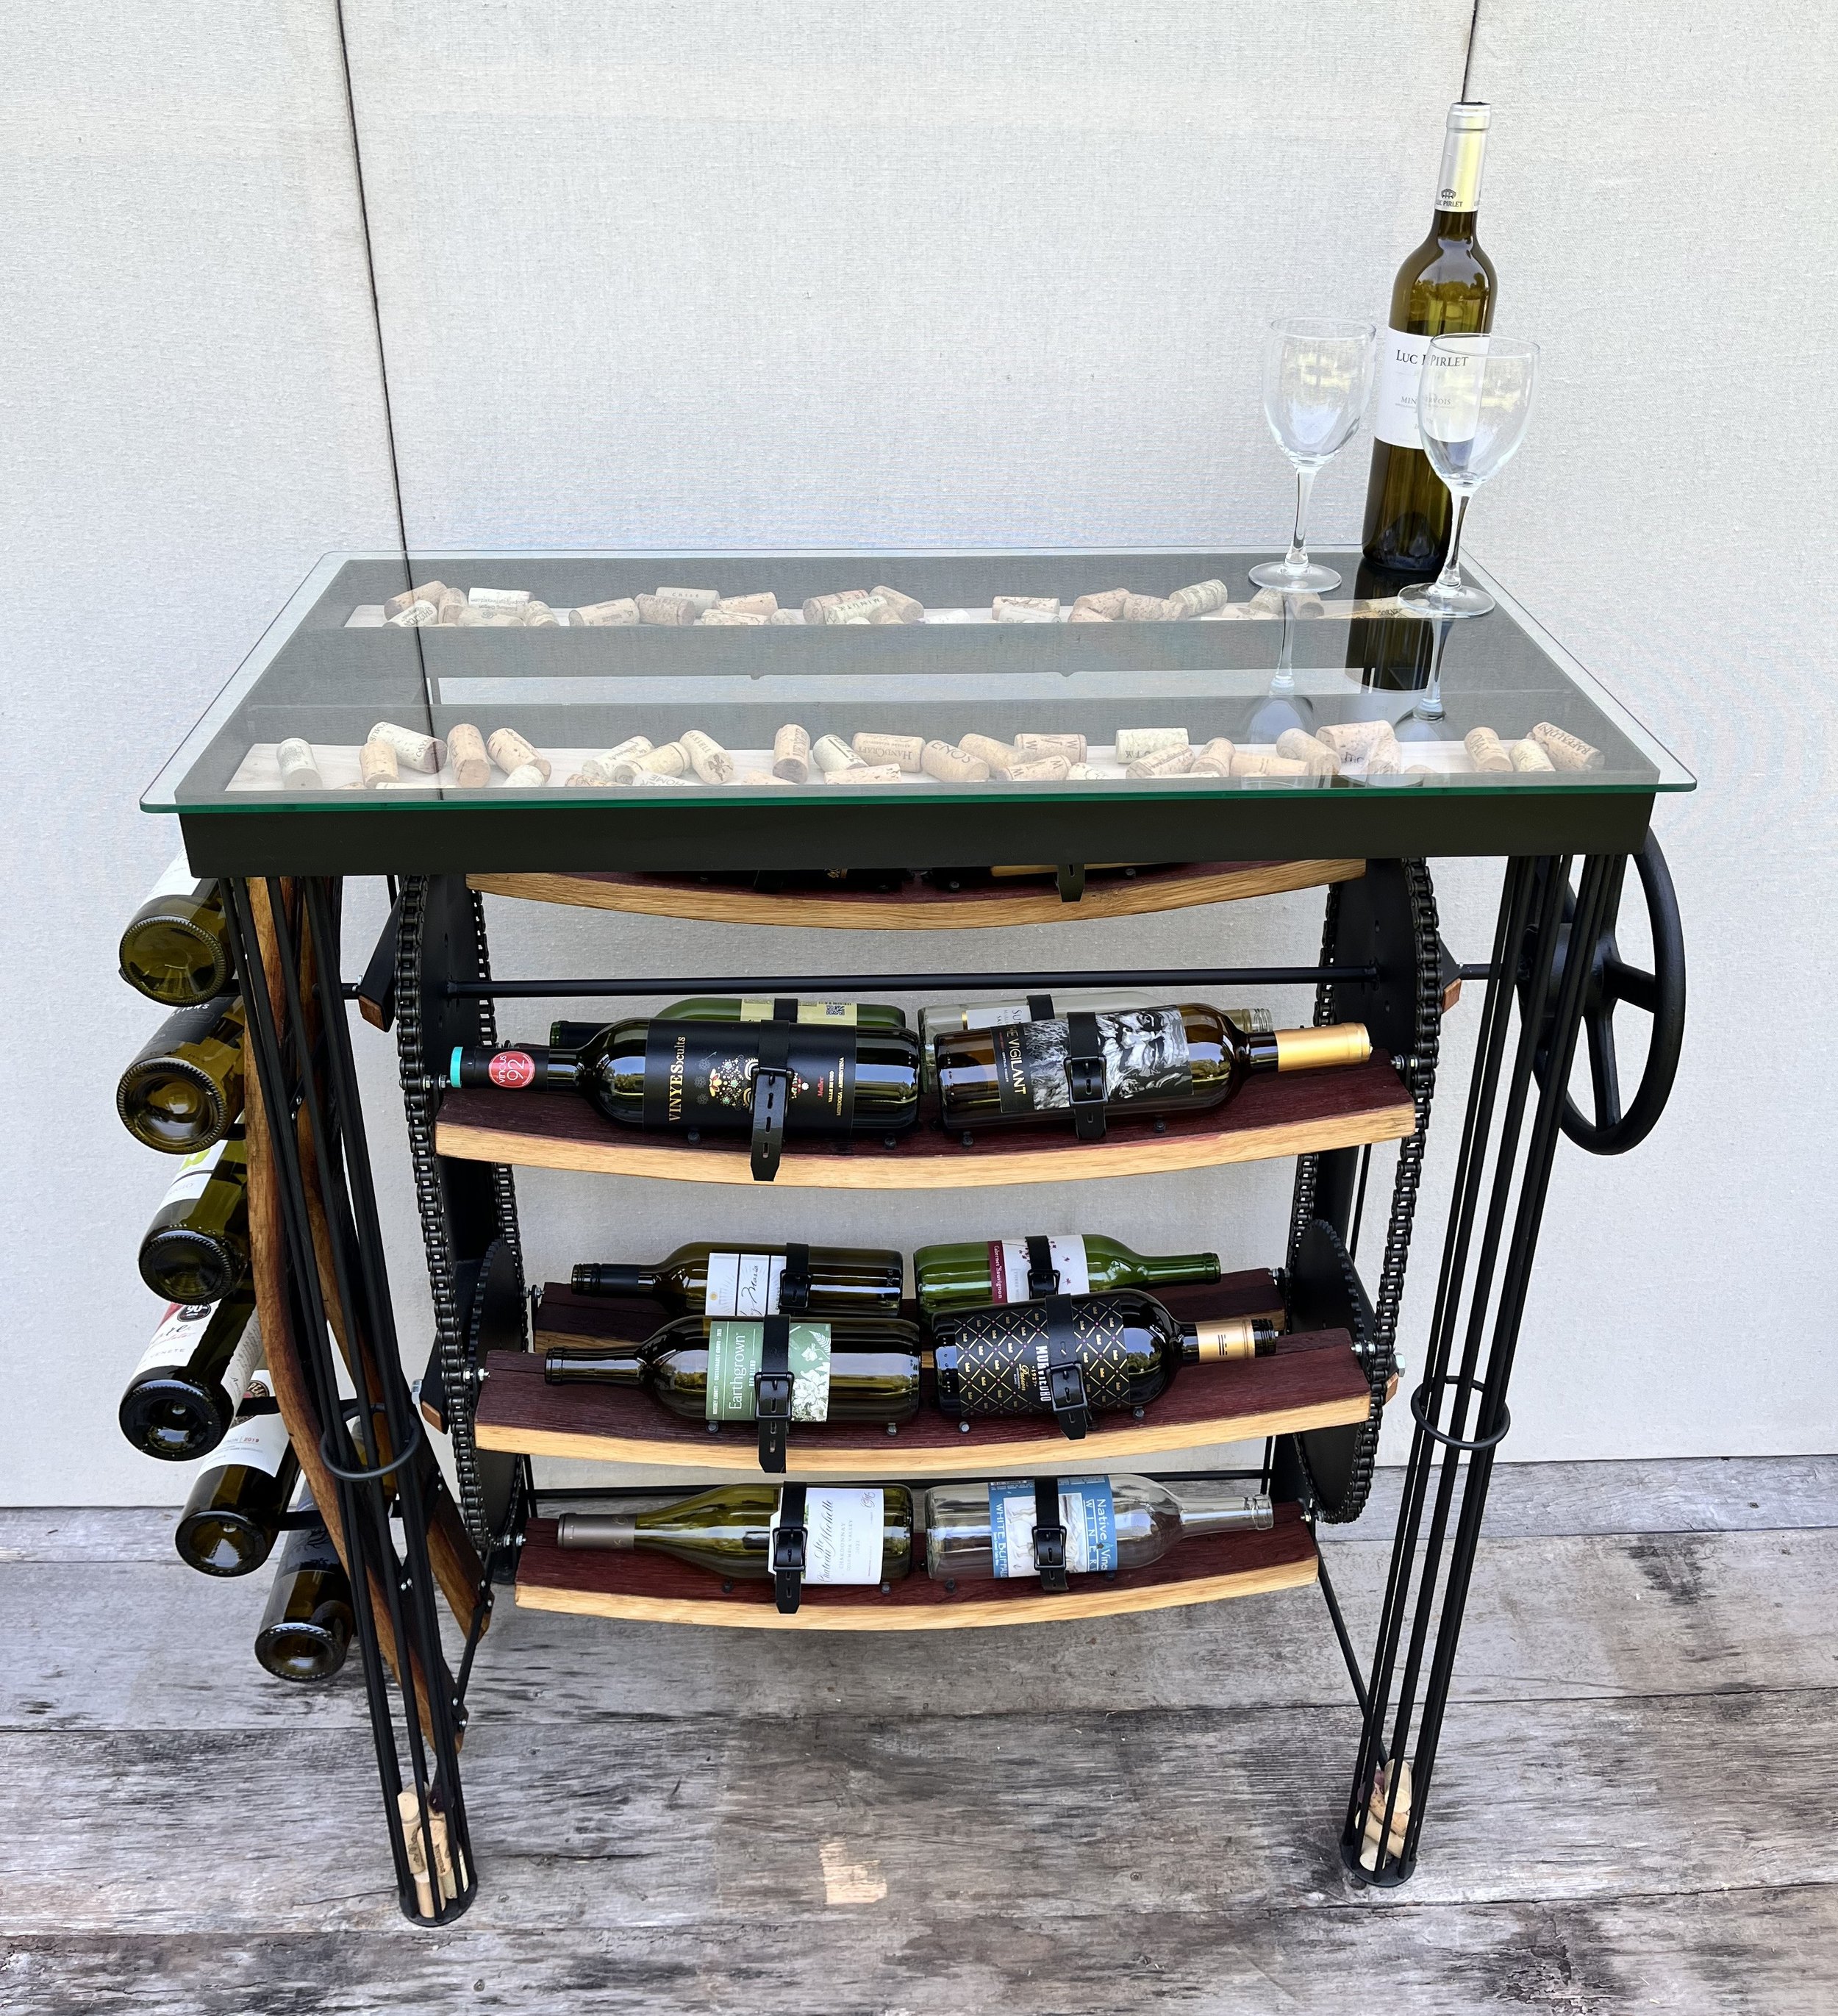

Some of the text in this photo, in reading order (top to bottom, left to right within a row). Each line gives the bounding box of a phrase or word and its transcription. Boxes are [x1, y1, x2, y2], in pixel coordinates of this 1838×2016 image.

[1396, 349, 1468, 366] LUC PIRLET
[931, 740, 972, 763] ENOS
[1537, 723, 1592, 755] RAFFALDINI
[498, 1055, 507, 1084] vinous
[506, 1059, 525, 1081] 92
[1008, 1038, 1027, 1094] VIGILANT
[729, 1335, 747, 1409] Earthgrown
[995, 1504, 1006, 1540] WHITE
[1096, 1499, 1109, 1541] Native
